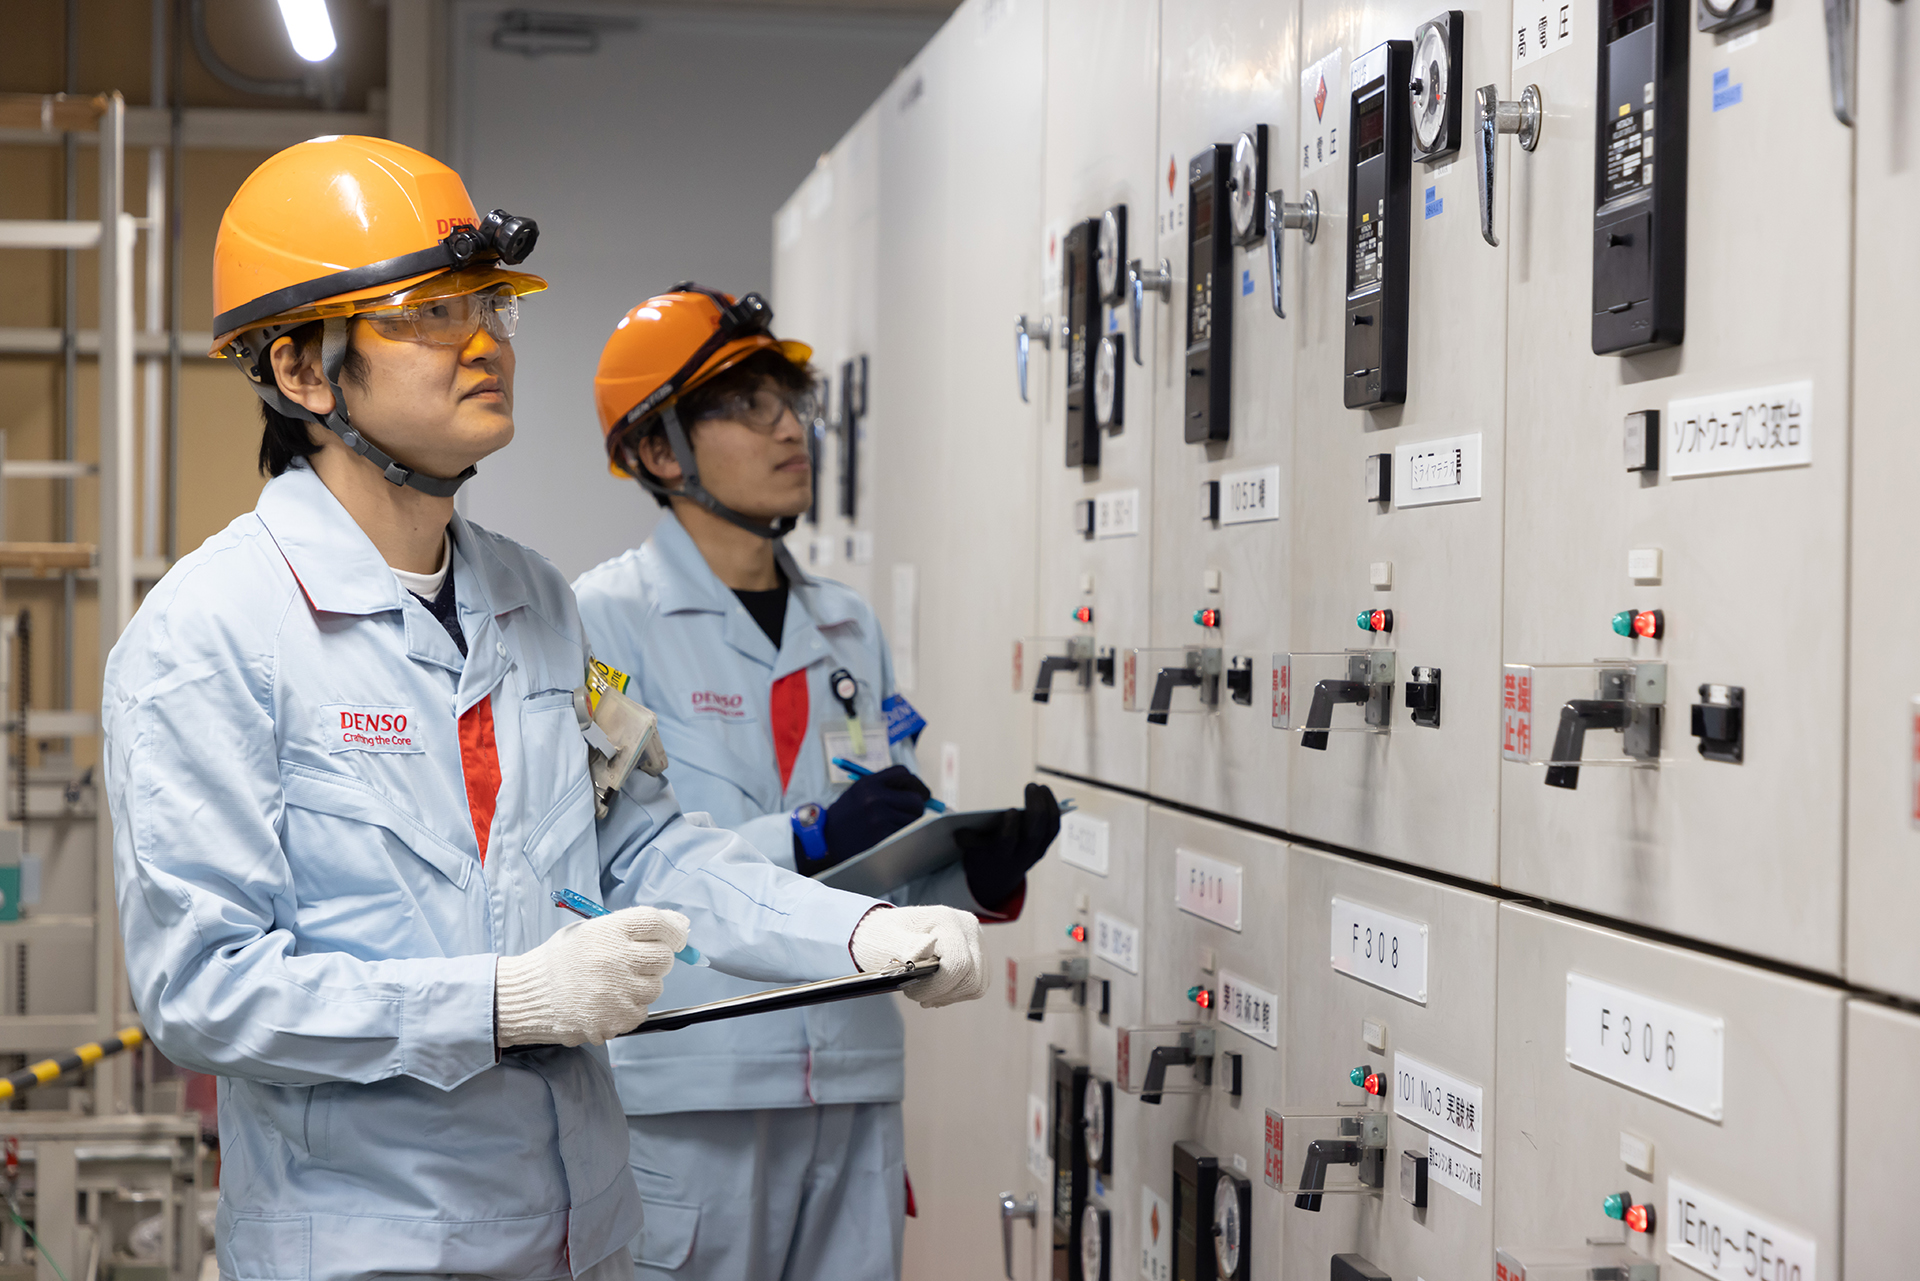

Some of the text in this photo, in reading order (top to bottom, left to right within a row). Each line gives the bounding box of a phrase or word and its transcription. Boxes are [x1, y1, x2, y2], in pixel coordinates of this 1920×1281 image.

[1517, 4, 1570, 60] 高電圧
[1674, 399, 1802, 453] ソフトウェアC3変台
[1414, 461, 1455, 482] ミライマテラス
[340, 712, 407, 733] DENSO
[692, 691, 743, 708] DENSO
[343, 733, 412, 747] Crafting the Core
[1353, 923, 1399, 969] F308
[1602, 1008, 1676, 1071] F306
[1398, 1070, 1476, 1132] 101 No.3 実験棟
